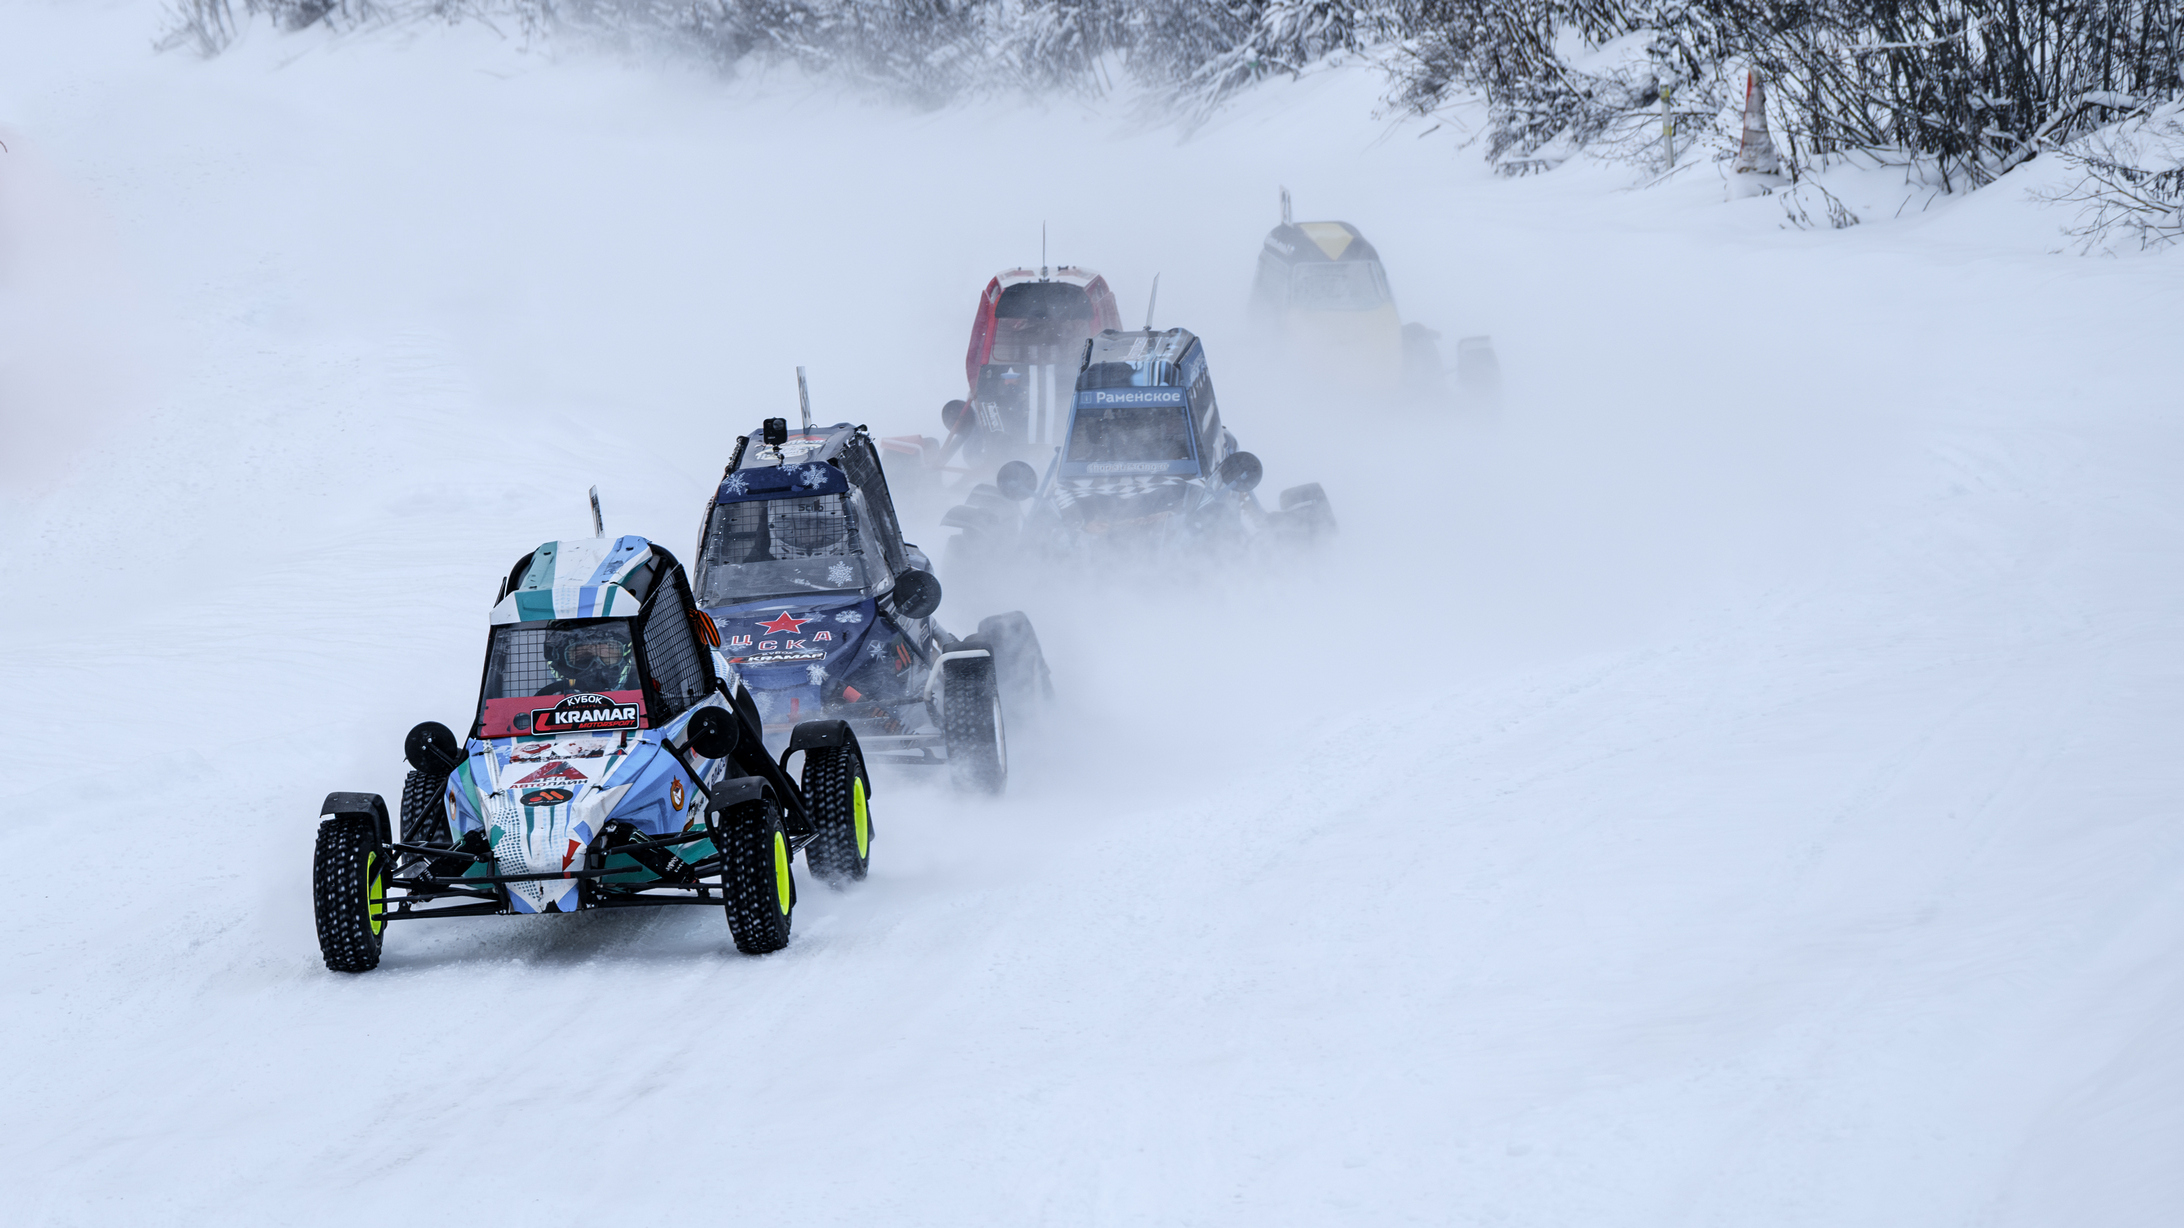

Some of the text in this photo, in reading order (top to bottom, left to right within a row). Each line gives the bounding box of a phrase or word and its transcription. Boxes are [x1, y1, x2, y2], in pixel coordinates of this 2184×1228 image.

[1096, 391, 1181, 404] Раменское
[731, 630, 832, 651] ЦСКА
[748, 652, 824, 662] KRAMAR
[567, 695, 603, 706] КУБОК
[555, 707, 636, 724] KRAMAR
[578, 719, 636, 729] MOTORSPORT
